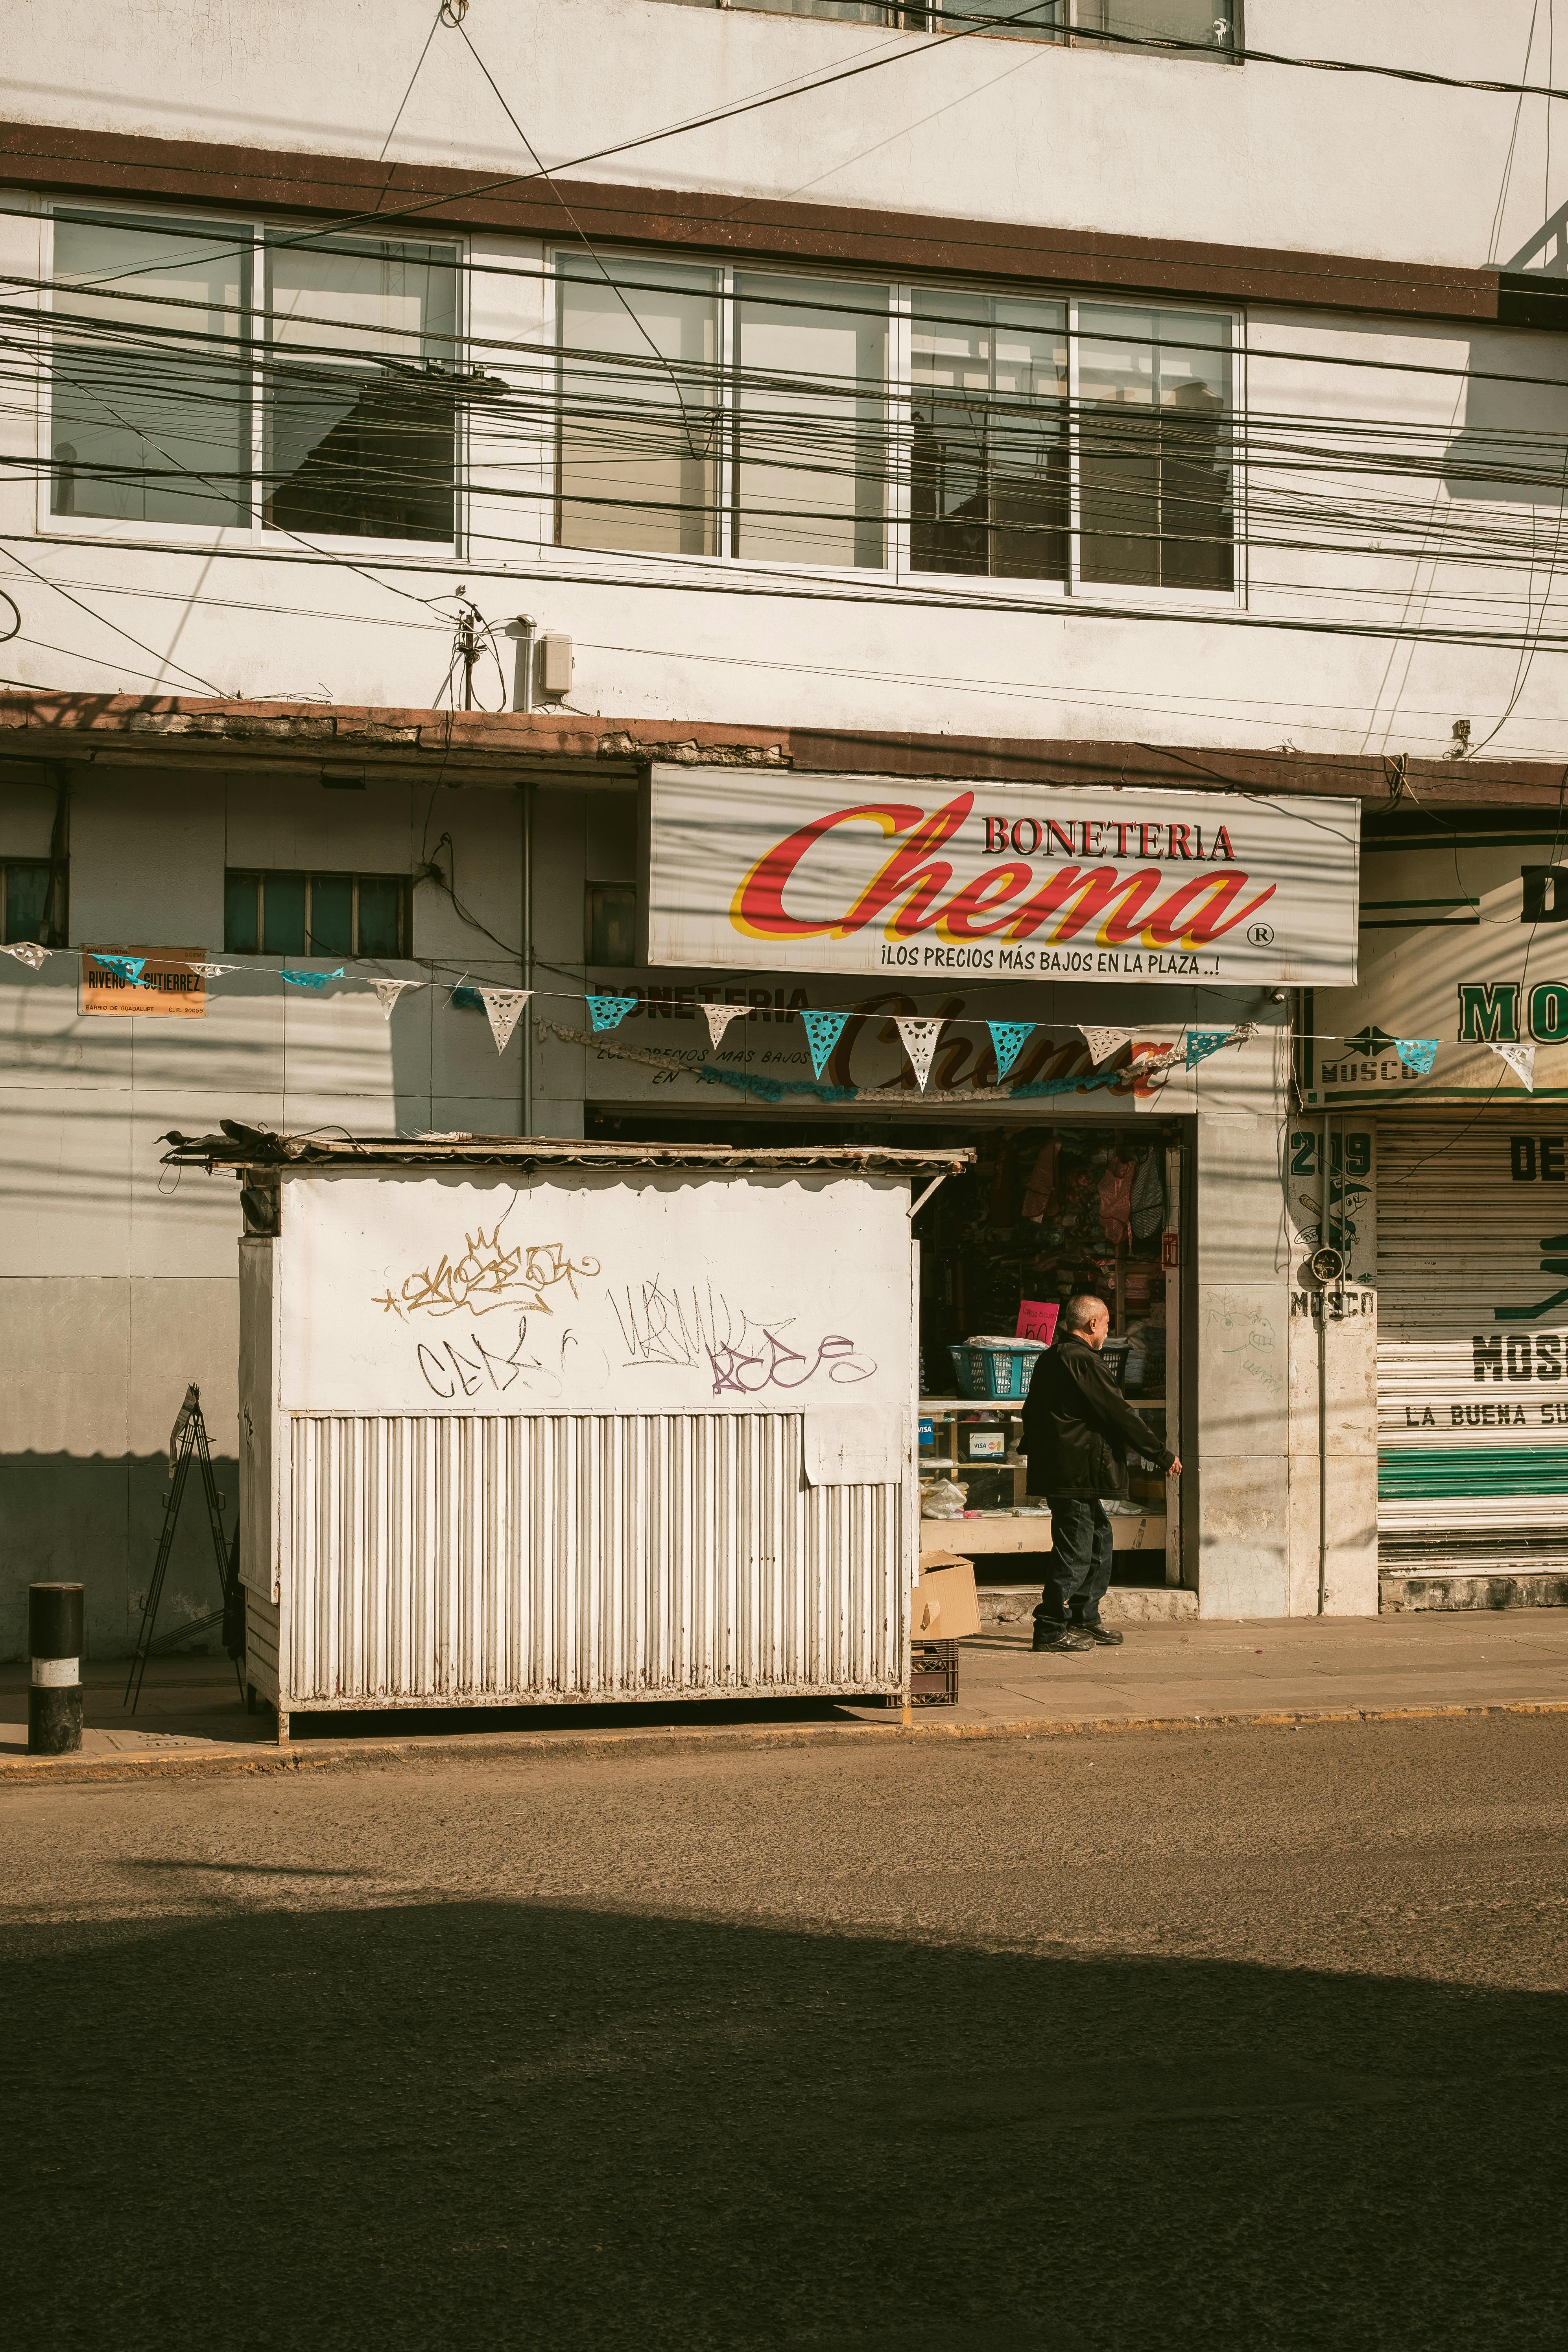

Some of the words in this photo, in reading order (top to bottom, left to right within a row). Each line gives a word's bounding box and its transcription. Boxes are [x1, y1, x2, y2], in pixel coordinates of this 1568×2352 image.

[982, 816, 1238, 862] BONETERIA
[729, 791, 1277, 951] Chema
[924, 947, 994, 968] PRECIOS
[999, 945, 1035, 970] MÁS
[1040, 951, 1093, 972] BAJOS
[1098, 953, 1119, 973] EN
[1123, 954, 1143, 973] LA
[1148, 954, 1199, 974] PLAZA
[144, 972, 201, 991] GUTIERREZ
[1457, 981, 1568, 1045] MO
[715, 1050, 756, 1063] MAS
[761, 1051, 811, 1064] BAJOS
[651, 1071, 680, 1085] EN
[1322, 1061, 1419, 1083] MOSCO
[1291, 1131, 1371, 1177] 209
[1025, 1323, 1047, 1343] 50
[1472, 1335, 1568, 1382] MOS
[1406, 1406, 1435, 1426] LA
[1451, 1405, 1526, 1426] BUENA
